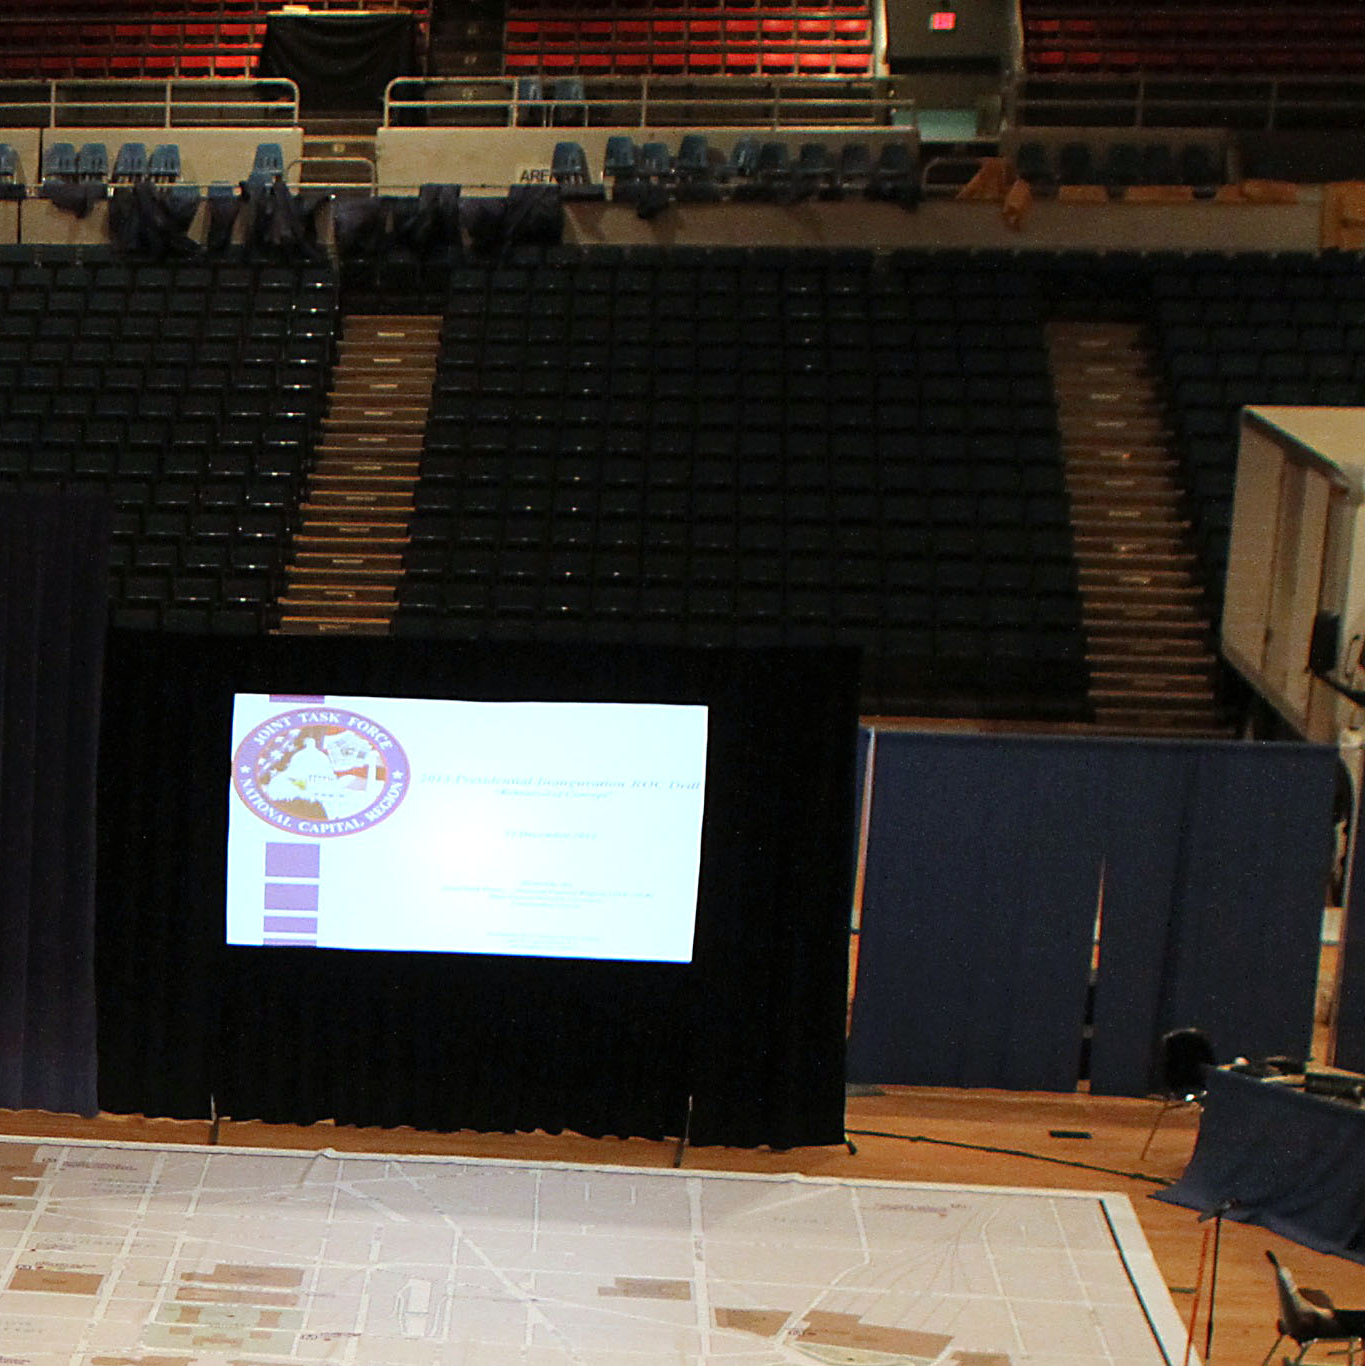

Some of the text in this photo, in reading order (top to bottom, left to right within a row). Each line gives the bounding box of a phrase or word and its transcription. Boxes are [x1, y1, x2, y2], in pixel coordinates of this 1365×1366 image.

[254, 711, 394, 751] JOINT TASK FORCE
[455, 774, 533, 786] Presidential
[239, 777, 404, 835] NATIONAL CAPITAL REGION
